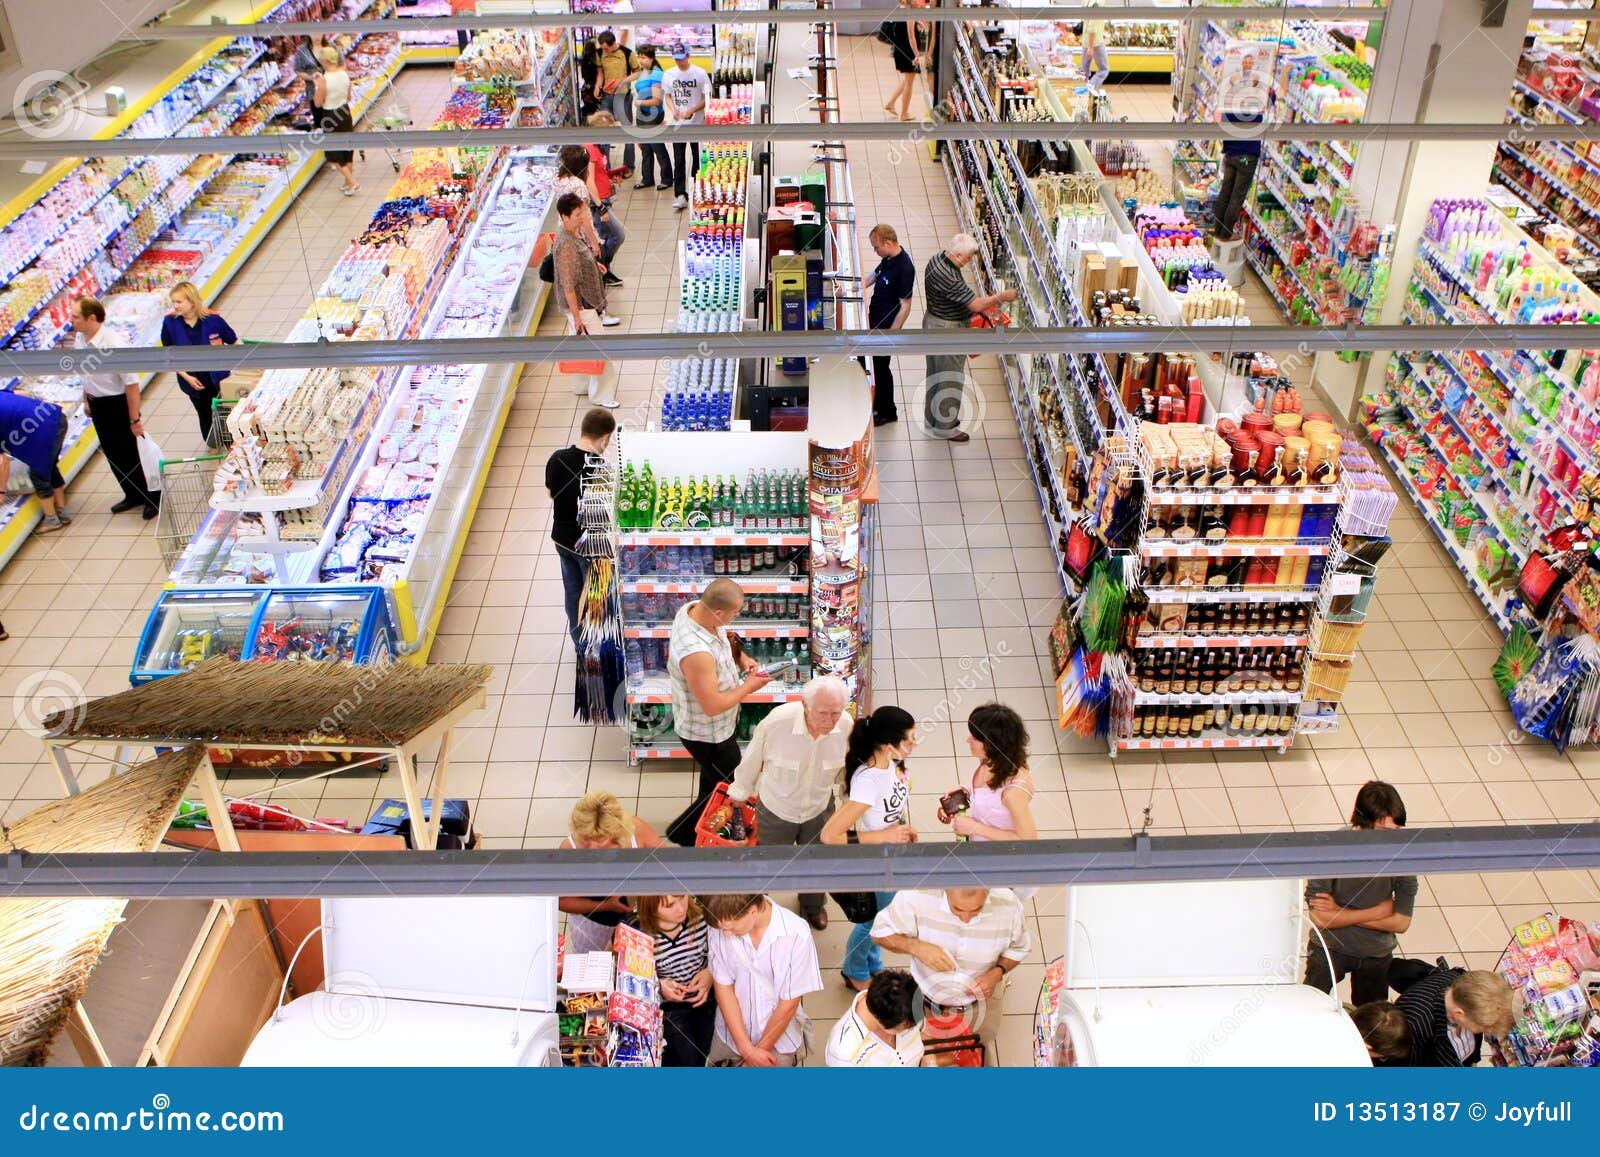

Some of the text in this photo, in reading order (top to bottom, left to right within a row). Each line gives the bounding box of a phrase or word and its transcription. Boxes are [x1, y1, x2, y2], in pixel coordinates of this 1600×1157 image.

[673, 79, 697, 88] Steal
[674, 88, 692, 97] this
[818, 486, 852, 494] СИГАРИ
[883, 781, 908, 813] Let's
